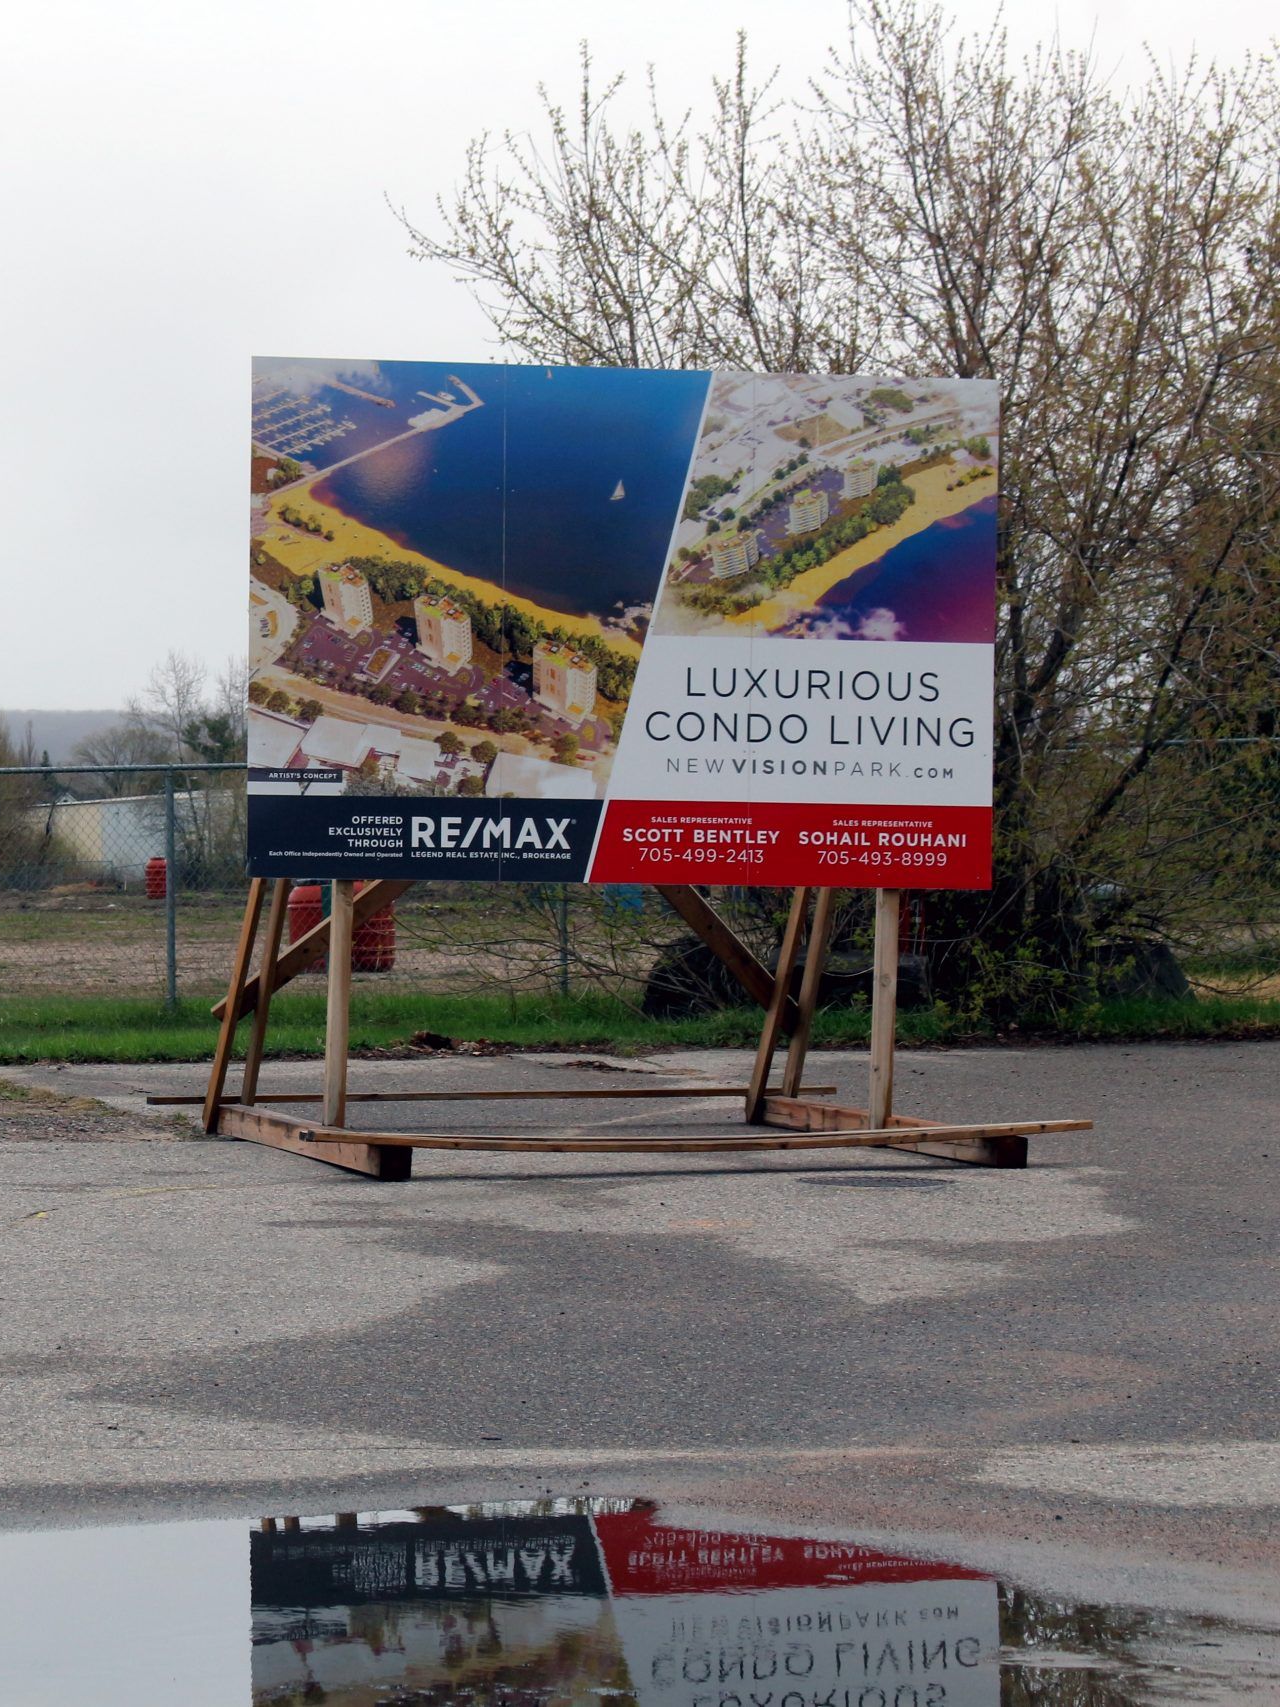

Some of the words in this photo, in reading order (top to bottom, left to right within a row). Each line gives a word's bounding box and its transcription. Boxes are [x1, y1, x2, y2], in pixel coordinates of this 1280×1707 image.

[686, 667, 940, 701] LUXURIOUS
[645, 711, 808, 744] CONDO
[830, 715, 974, 748] LIVING
[666, 758, 954, 779] NEWVISIONPARK.COM
[302, 772, 338, 780] CONCEPT
[351, 815, 404, 825] OFFERED
[650, 816, 678, 824] SALES
[680, 816, 753, 825] REPRESENTATIVE
[832, 819, 859, 827] SALES
[861, 820, 933, 828] REPRESENTATIVE
[328, 827, 404, 837] EXCLUSIVELY
[411, 816, 571, 850] RE/MAX
[622, 828, 684, 843] SCOTT
[693, 829, 780, 844] BENTLEY
[347, 838, 404, 848] THROUGH
[798, 831, 871, 846] SOHAIL
[878, 832, 967, 848] ROUHANI
[302, 850, 343, 858] Independently
[376, 851, 404, 859] Operated
[445, 851, 467, 859] REAL
[500, 852, 520, 860] INC.,
[522, 852, 572, 860] BROKERAGE
[638, 847, 764, 863] 705-499-2413
[817, 850, 947, 866] 705-493-8999
